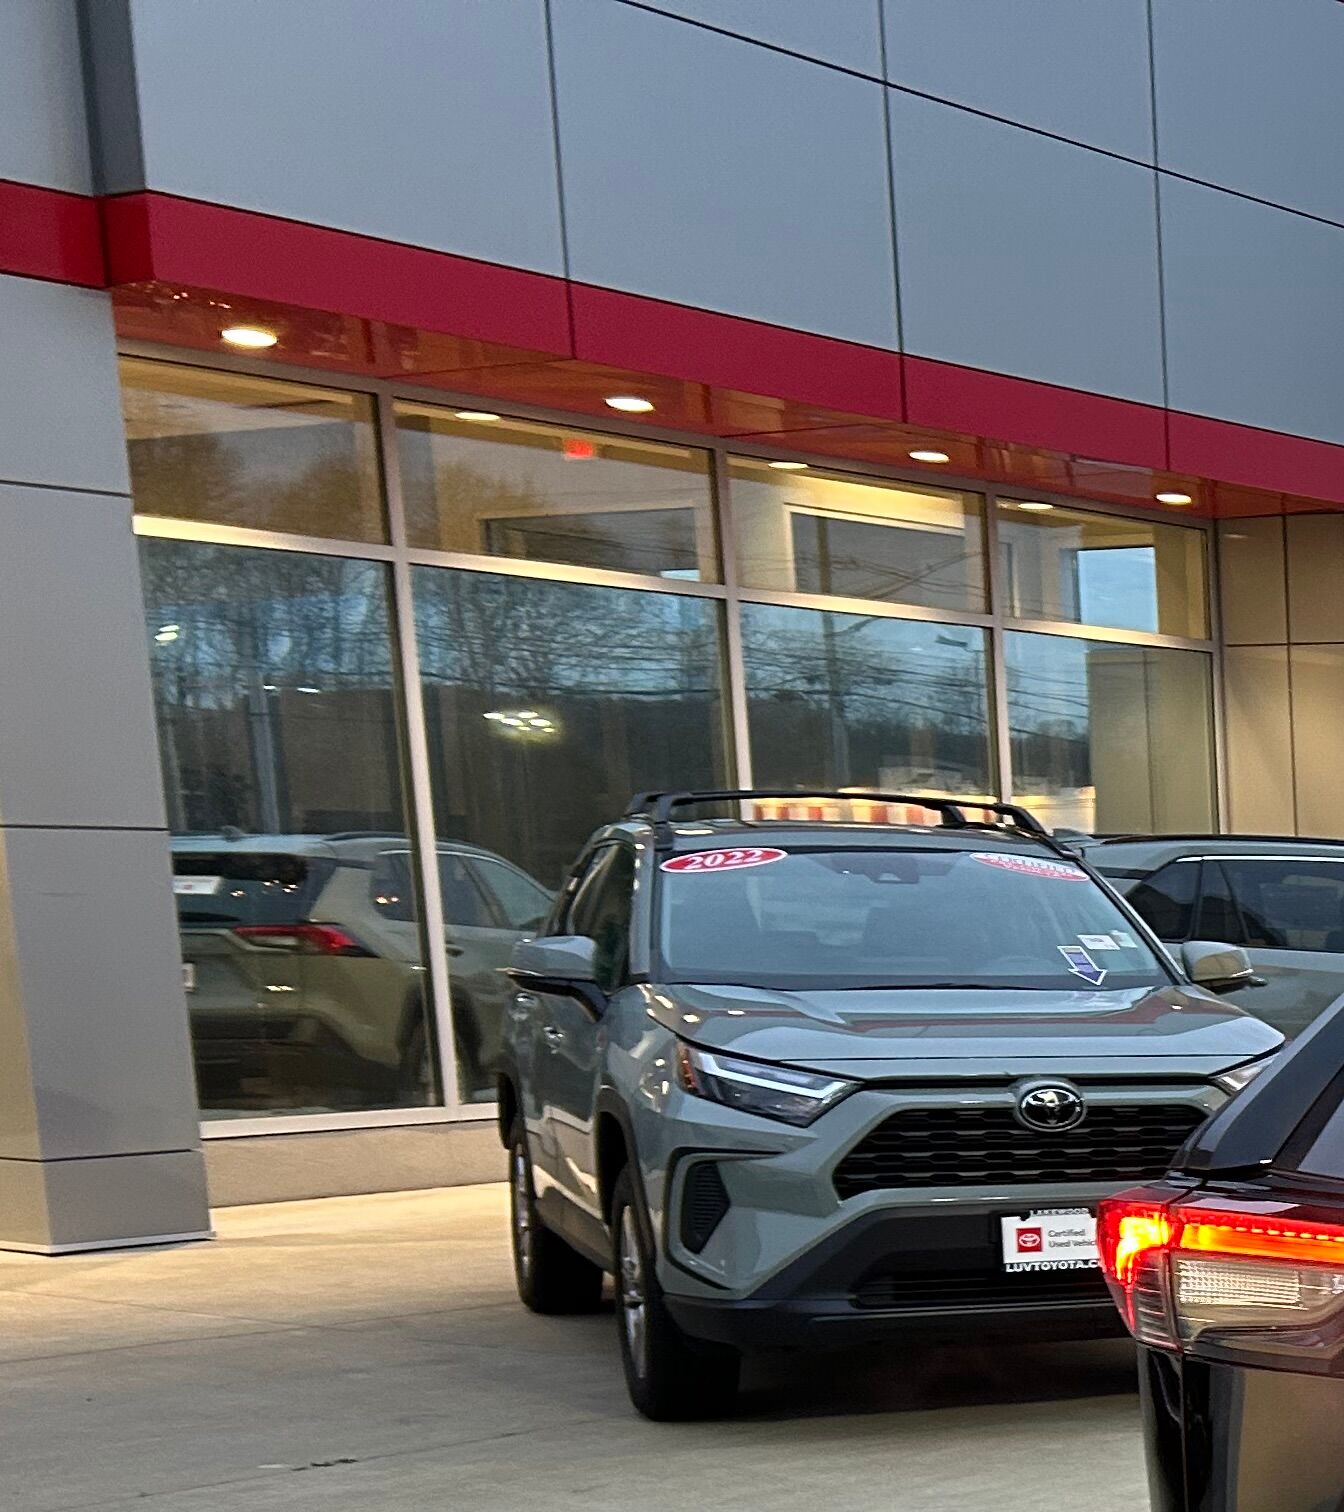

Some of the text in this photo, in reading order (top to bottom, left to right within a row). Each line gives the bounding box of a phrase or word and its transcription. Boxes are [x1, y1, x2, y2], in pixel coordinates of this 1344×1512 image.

[684, 850, 763, 869] 2022
[1048, 1229, 1085, 1237] Certified
[1049, 1239, 1097, 1248] Used Vehic
[1006, 1259, 1099, 1272] LUVTOYOTA.C
